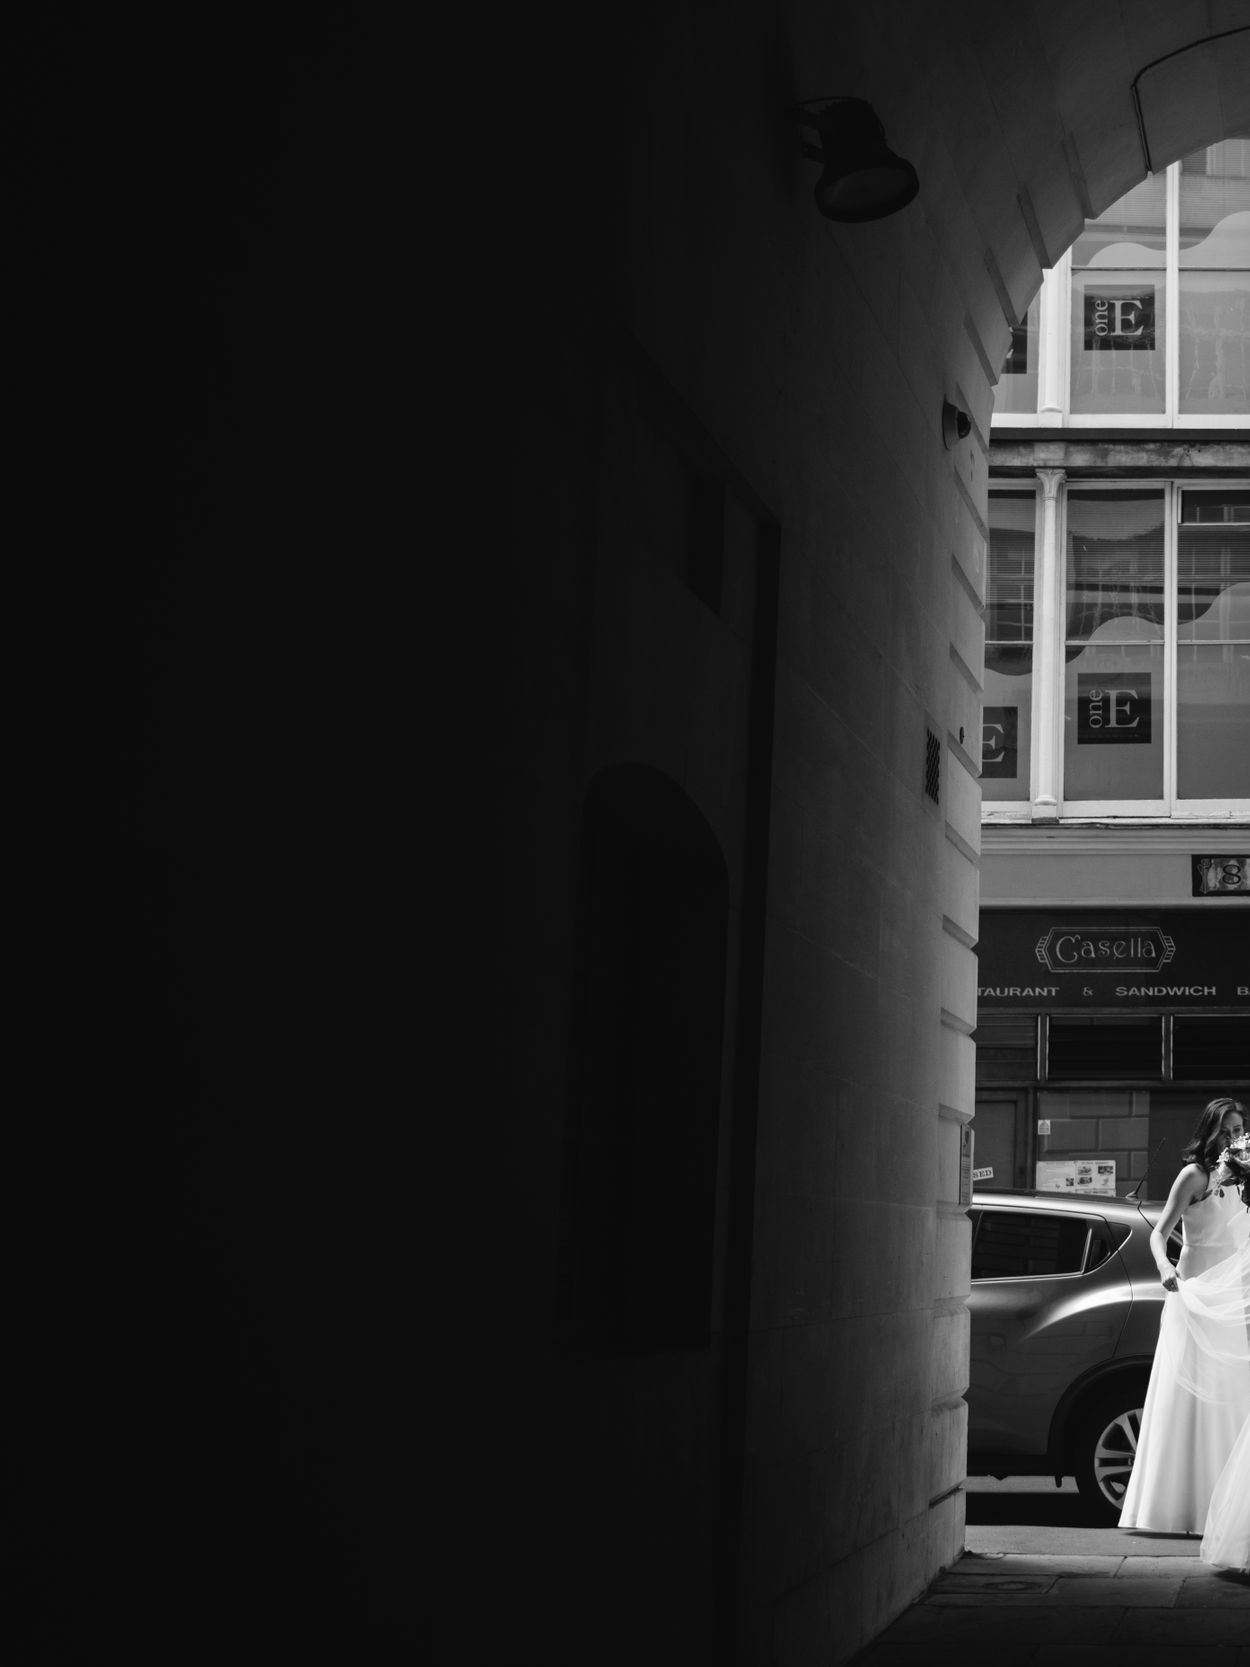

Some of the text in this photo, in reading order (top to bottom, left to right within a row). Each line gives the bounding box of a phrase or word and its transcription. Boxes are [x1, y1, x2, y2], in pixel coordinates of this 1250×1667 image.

[1094, 299, 1145, 336] one E
[1088, 689, 1140, 728] one E
[1055, 934, 1157, 963] Casella
[1083, 987, 1094, 997] &
[1115, 986, 1217, 997] SANDWICH
